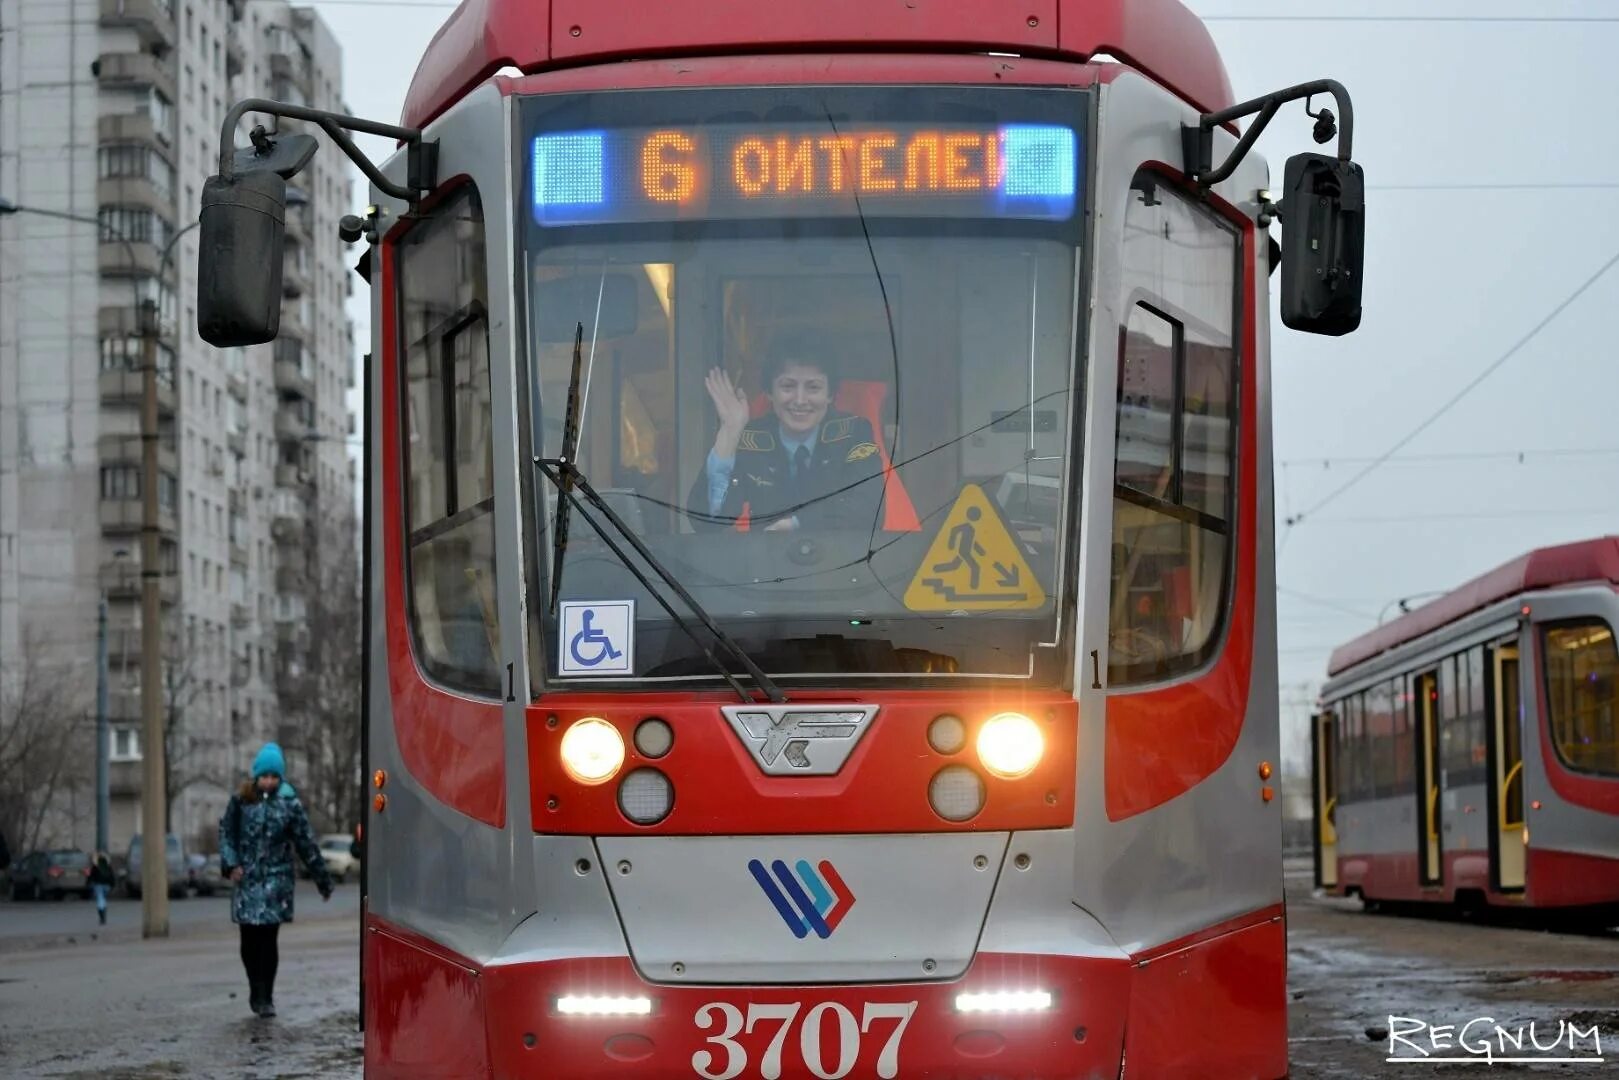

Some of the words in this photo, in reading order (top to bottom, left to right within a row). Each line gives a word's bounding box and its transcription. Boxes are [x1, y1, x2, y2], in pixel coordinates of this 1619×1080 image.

[643, 133, 694, 201] 6
[506, 661, 516, 702] 1
[1090, 649, 1102, 689] 1
[691, 1000, 919, 1080] 3707
